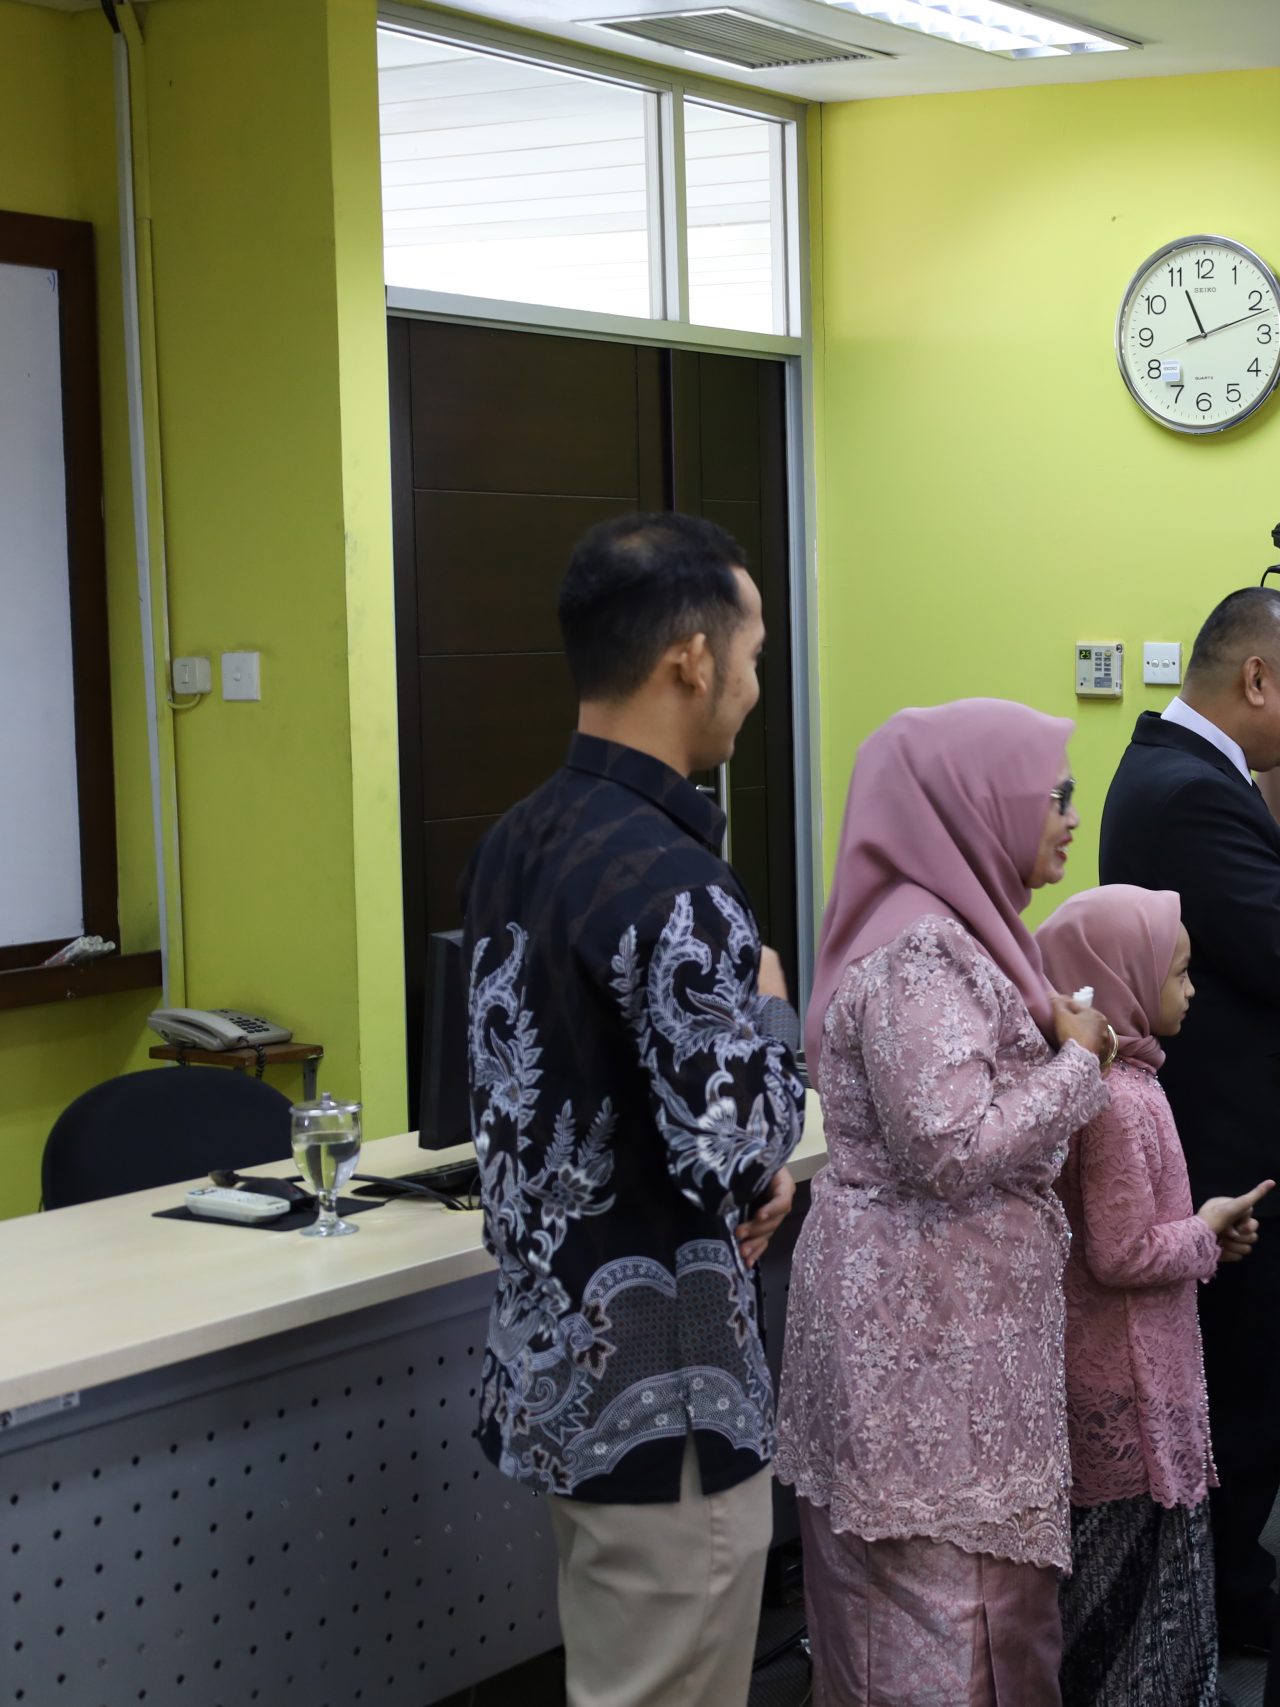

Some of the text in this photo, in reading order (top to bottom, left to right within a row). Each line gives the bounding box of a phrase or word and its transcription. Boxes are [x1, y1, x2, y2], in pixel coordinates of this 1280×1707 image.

[1168, 267, 1183, 287] 11
[1195, 258, 1215, 279] 12
[1231, 265, 1238, 285] 1
[1194, 286, 1217, 294] SEIKO
[1145, 294, 1167, 315] 10
[1248, 290, 1263, 311] 2
[1138, 328, 1154, 348] 9
[1256, 323, 1272, 344] 3
[1147, 358, 1162, 380] 8
[1246, 357, 1262, 378] 4
[1169, 384, 1185, 404] 7
[1195, 392, 1212, 412] 6
[1225, 383, 1242, 403] 5
